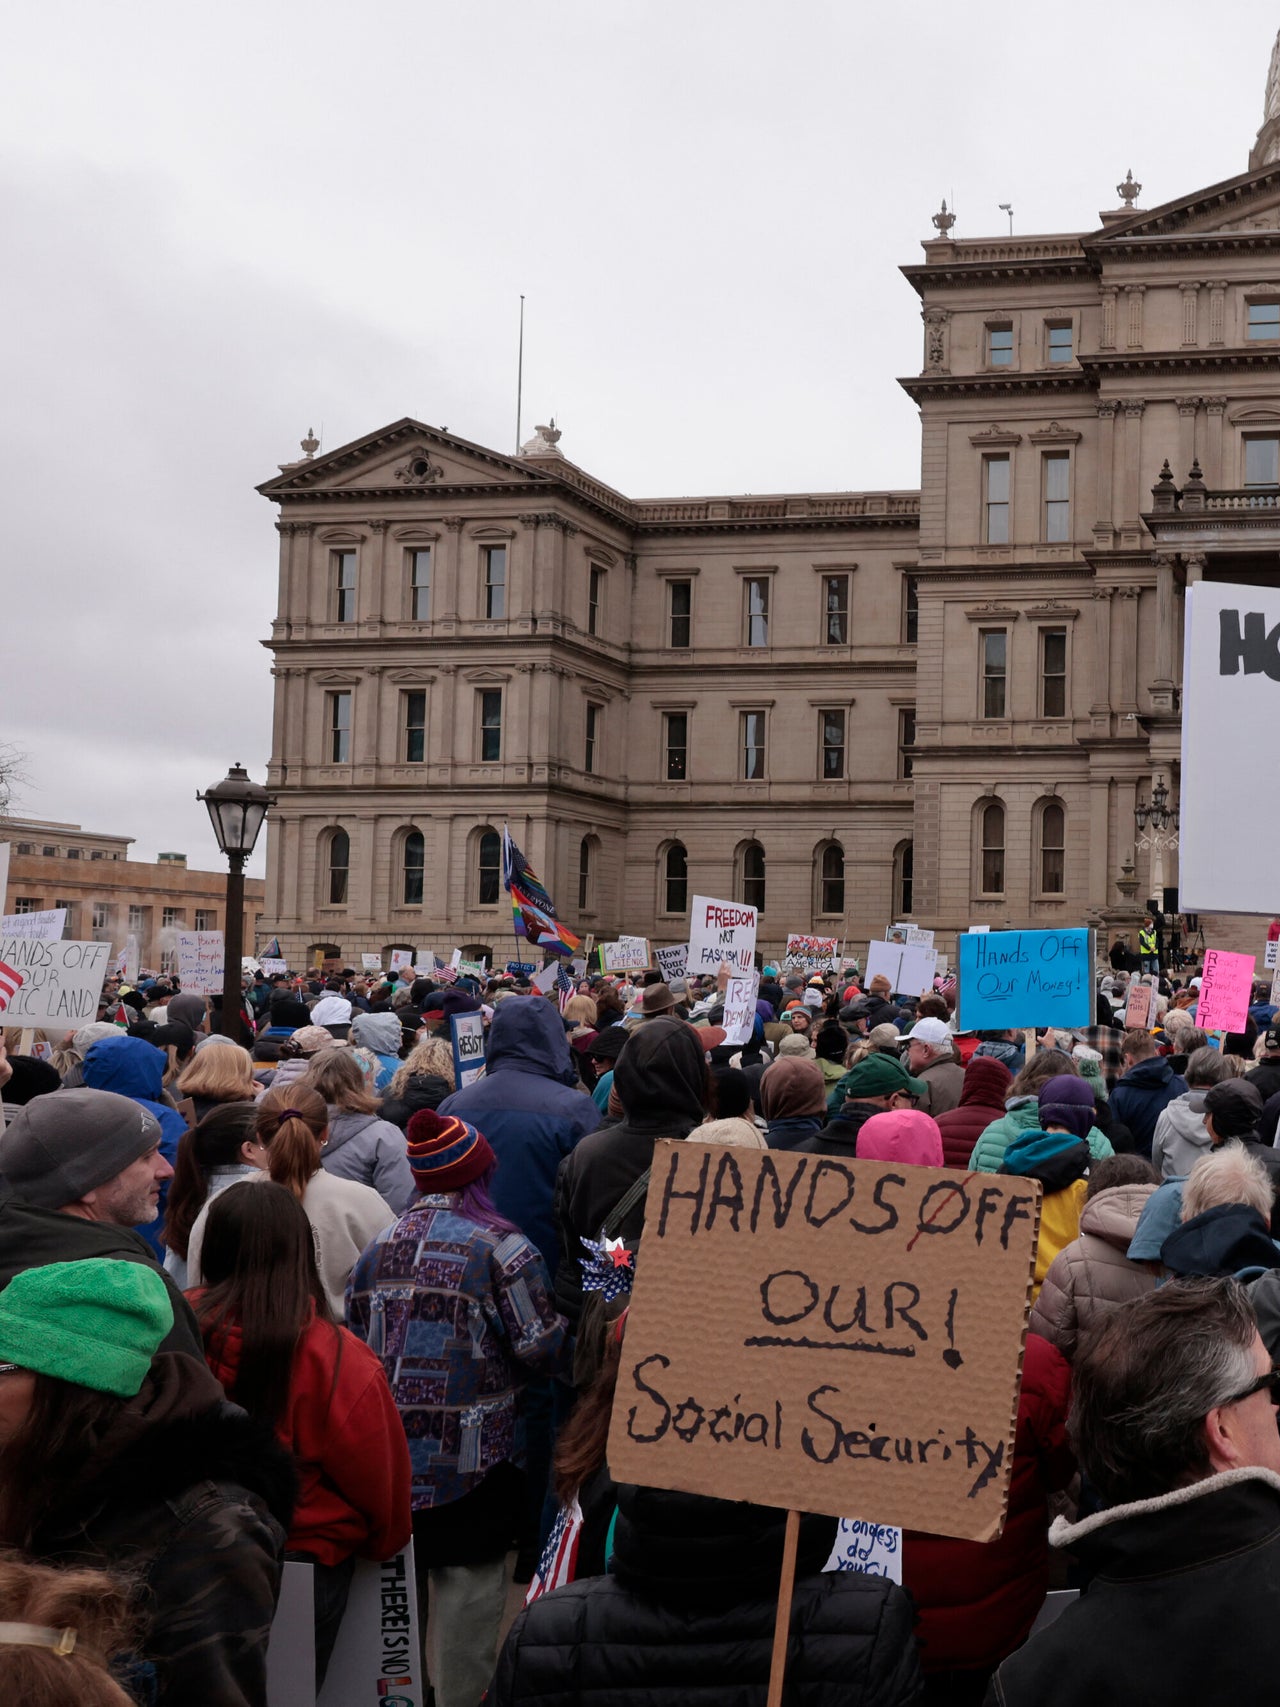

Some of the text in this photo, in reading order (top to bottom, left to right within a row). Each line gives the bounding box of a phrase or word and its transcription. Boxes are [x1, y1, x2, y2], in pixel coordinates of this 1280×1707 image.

[705, 905, 755, 929] FREEDOM
[719, 929, 735, 944] NOT
[63, 945, 107, 969] OFF
[657, 949, 681, 960] How
[660, 958, 684, 970] Your
[46, 988, 95, 1018] LAND
[458, 1034, 483, 1057] RESIST
[656, 1151, 906, 1237] HANDS
[626, 1353, 1004, 1500] Social Security
[846, 1537, 869, 1562] do
[380, 1555, 411, 1628] THERE
[381, 1628, 410, 1648] IS
[381, 1649, 410, 1675] NO
